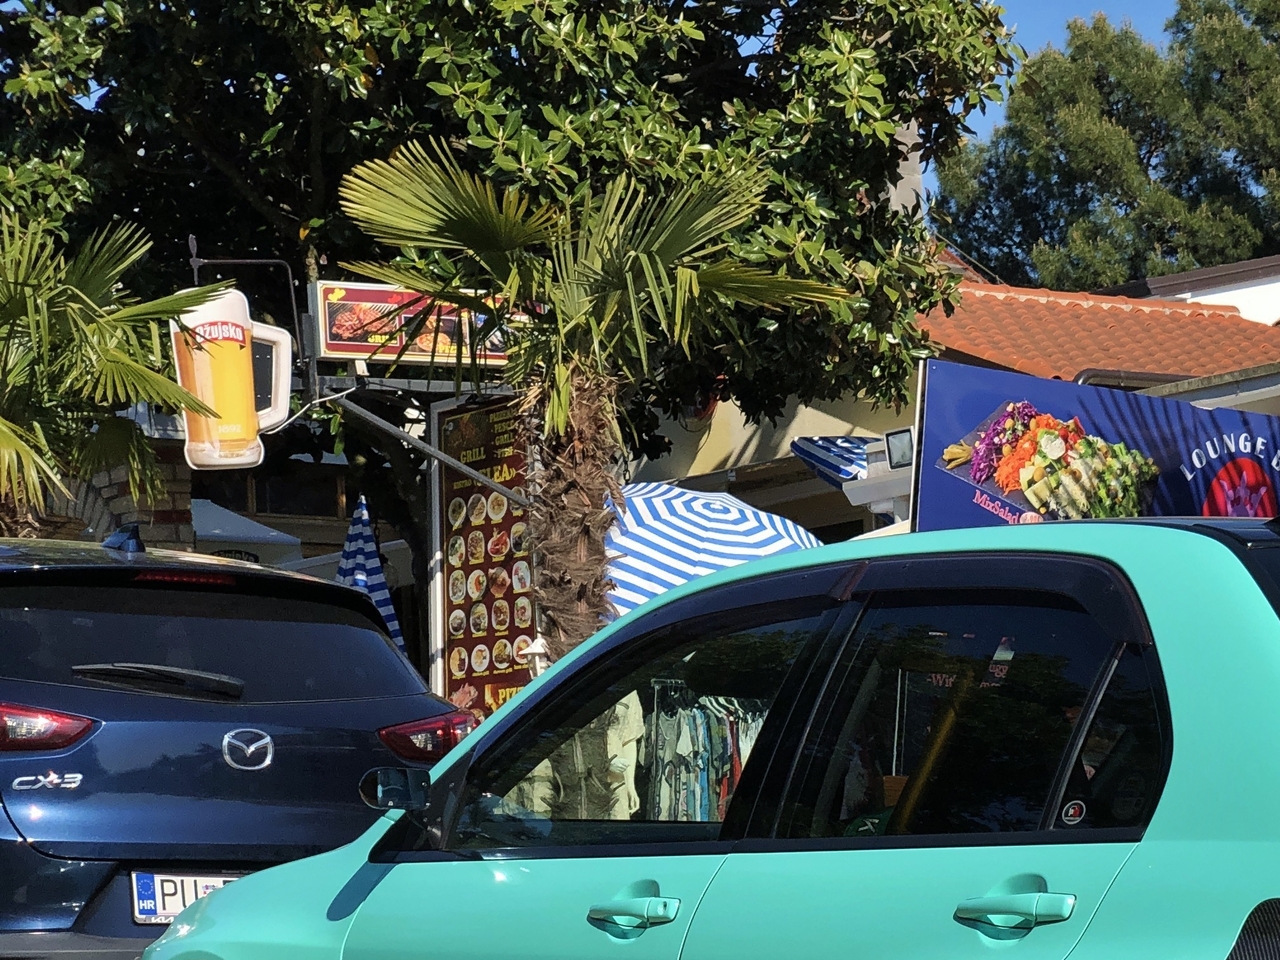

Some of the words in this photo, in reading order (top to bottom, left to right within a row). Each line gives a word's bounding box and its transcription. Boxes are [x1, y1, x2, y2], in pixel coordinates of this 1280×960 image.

[461, 446, 487, 464] GRILL
[1179, 432, 1267, 482] LOUNGE
[12, 773, 84, 791] CX-3
[160, 879, 199, 911] PU
[139, 900, 155, 910] HR
